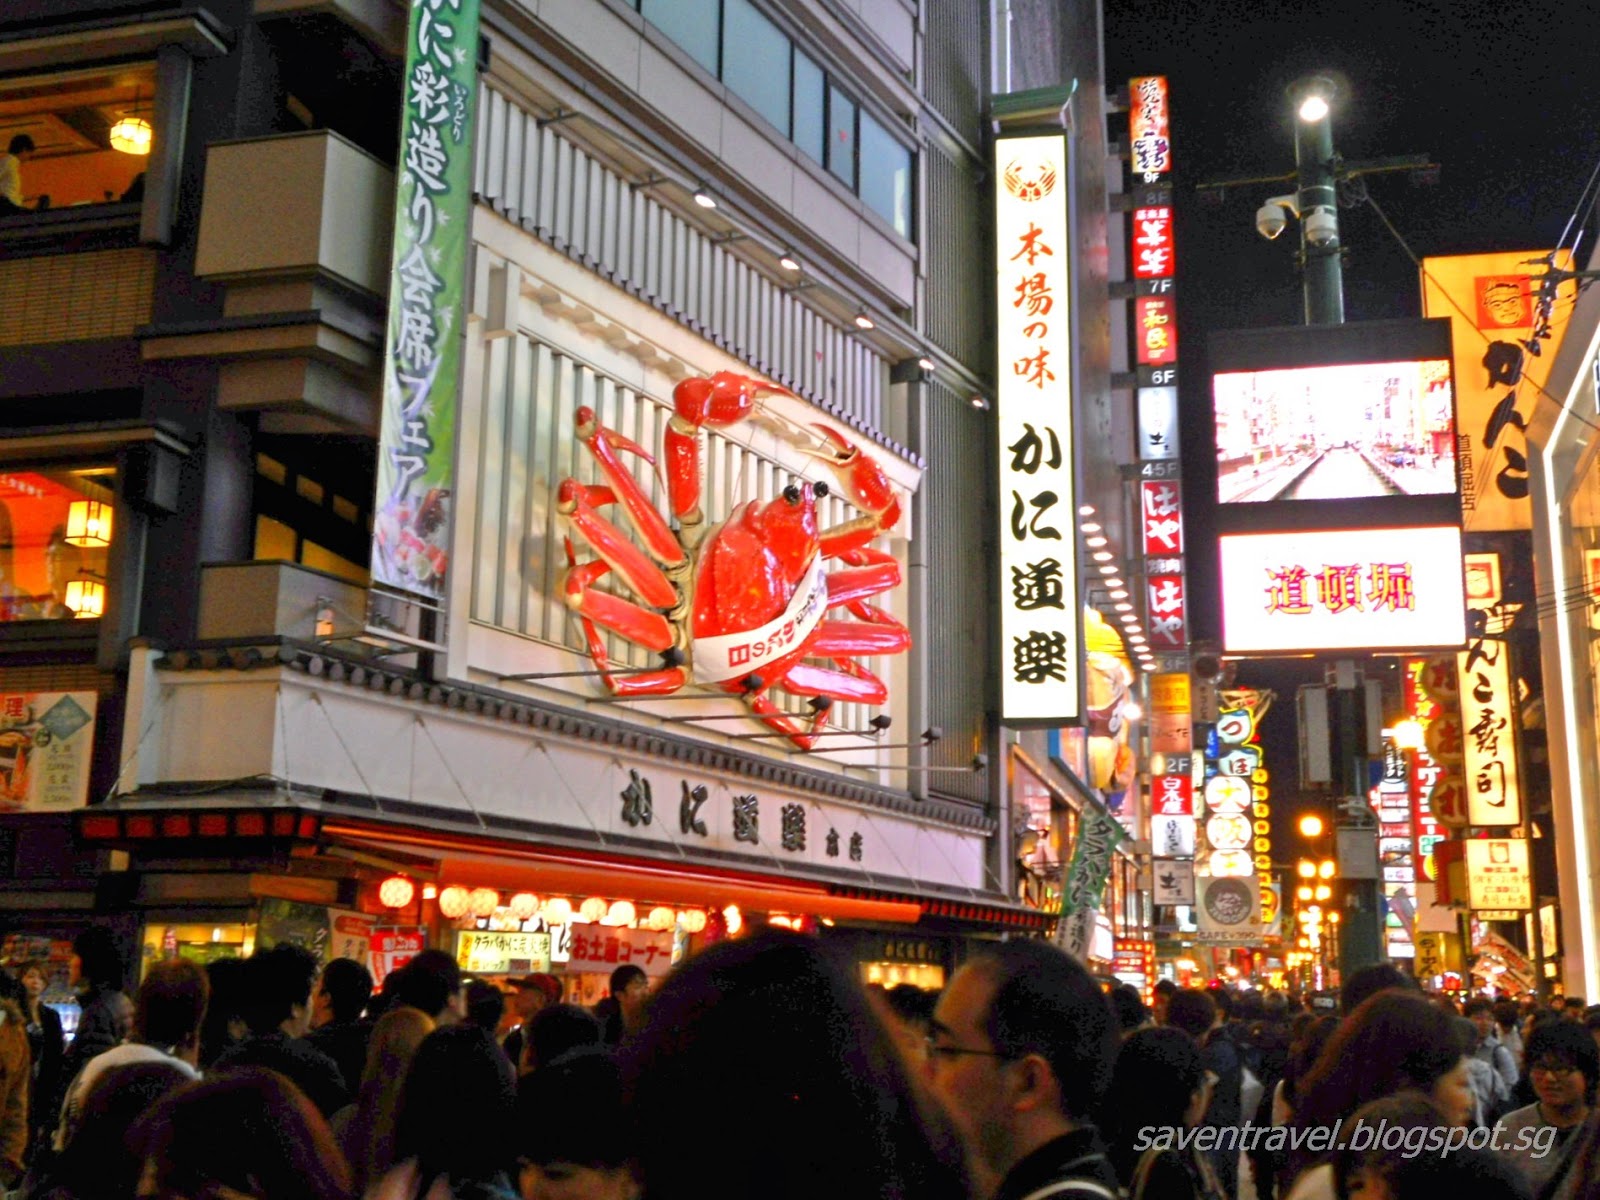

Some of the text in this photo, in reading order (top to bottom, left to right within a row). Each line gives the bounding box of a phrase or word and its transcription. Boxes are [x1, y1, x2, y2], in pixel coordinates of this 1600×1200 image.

[391, 0, 459, 500] に彩造り会席フェア
[1150, 280, 1172, 293] 7F
[1010, 222, 1055, 389] 本場の味
[1152, 370, 1175, 384] 6F
[1264, 563, 1415, 615] 道頓堀
[1167, 757, 1189, 772] 2F
[1160, 777, 1185, 813] 白木屋
[572, 933, 671, 965] お土産コーナー
